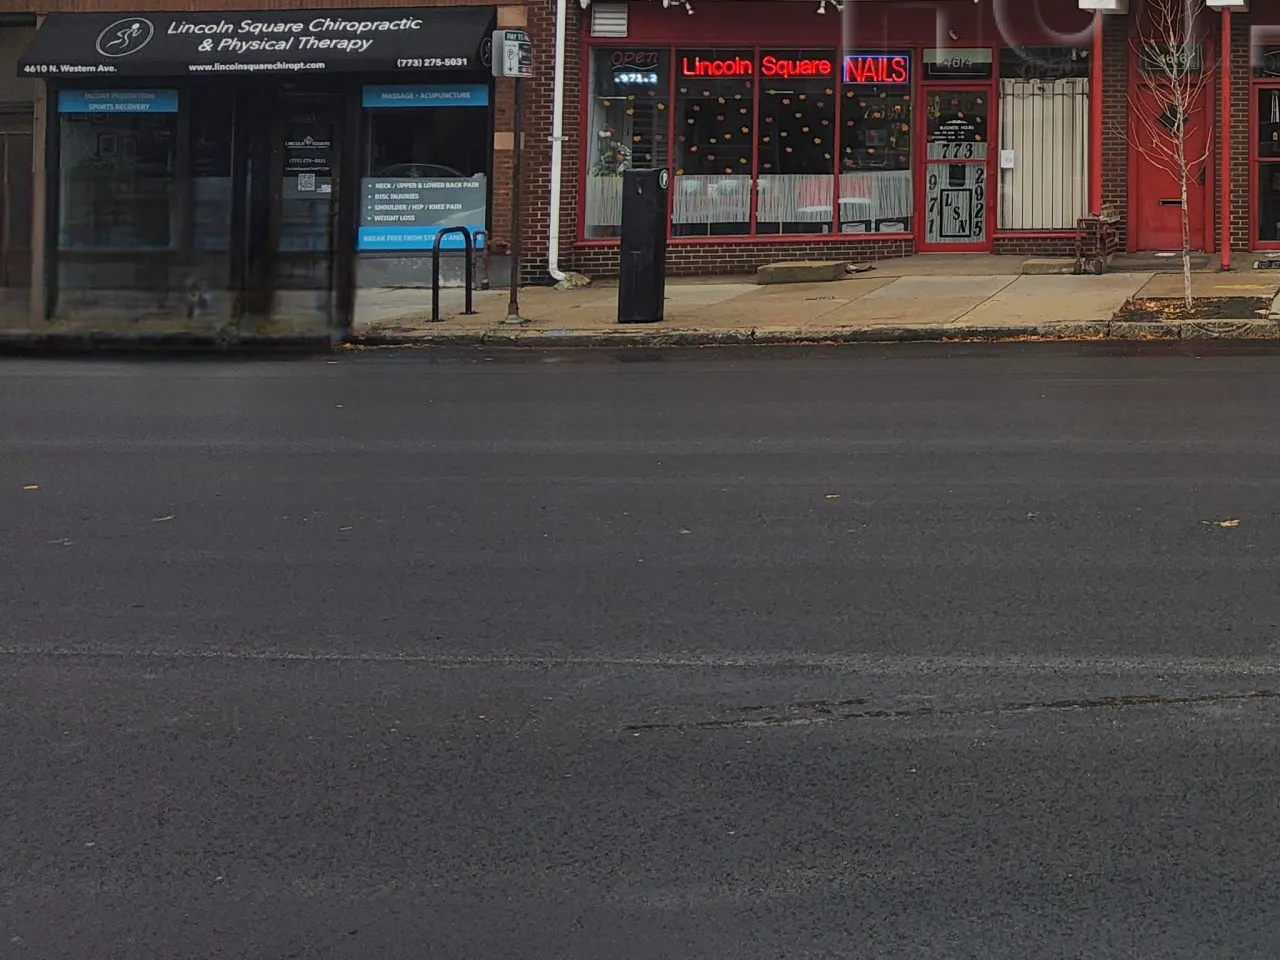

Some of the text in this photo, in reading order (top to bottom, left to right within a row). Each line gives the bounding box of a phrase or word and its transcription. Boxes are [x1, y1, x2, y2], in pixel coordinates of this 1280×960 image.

[167, 17, 422, 36] Lincoln Square Chiropractic
[198, 36, 373, 53] & Physical Therapy
[24, 64, 117, 73] 4610 N. Western Ave.
[189, 60, 325, 72] www.lincolnsquarechiropt.com
[397, 57, 468, 68] (773) 275-5031
[683, 55, 831, 78] Lincoln Square
[846, 57, 906, 82] NAILS
[943, 57, 973, 68] 4614
[942, 143, 973, 159] 773
